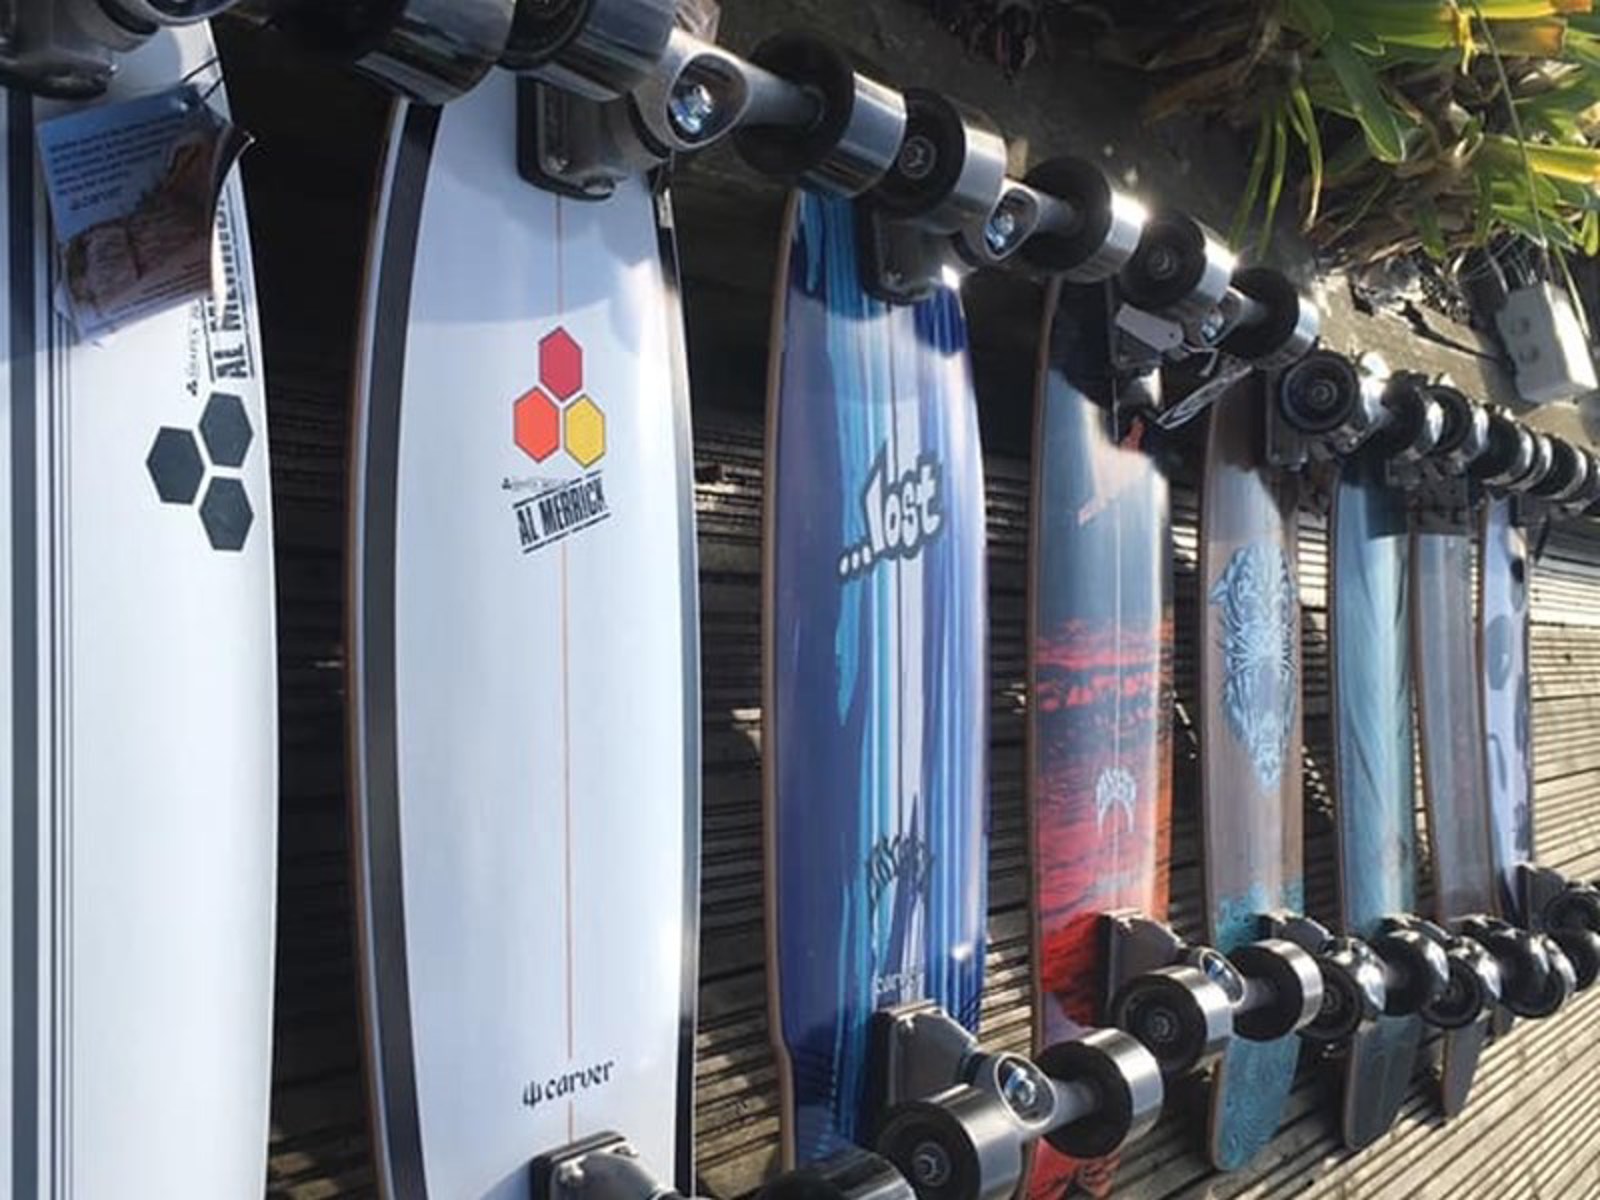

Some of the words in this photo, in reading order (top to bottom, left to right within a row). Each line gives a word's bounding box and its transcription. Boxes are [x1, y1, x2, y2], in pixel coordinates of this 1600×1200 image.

[214, 345, 248, 379] AL
[517, 506, 539, 546] AL
[538, 477, 607, 536] MERRICK
[545, 1060, 615, 1101] carver
